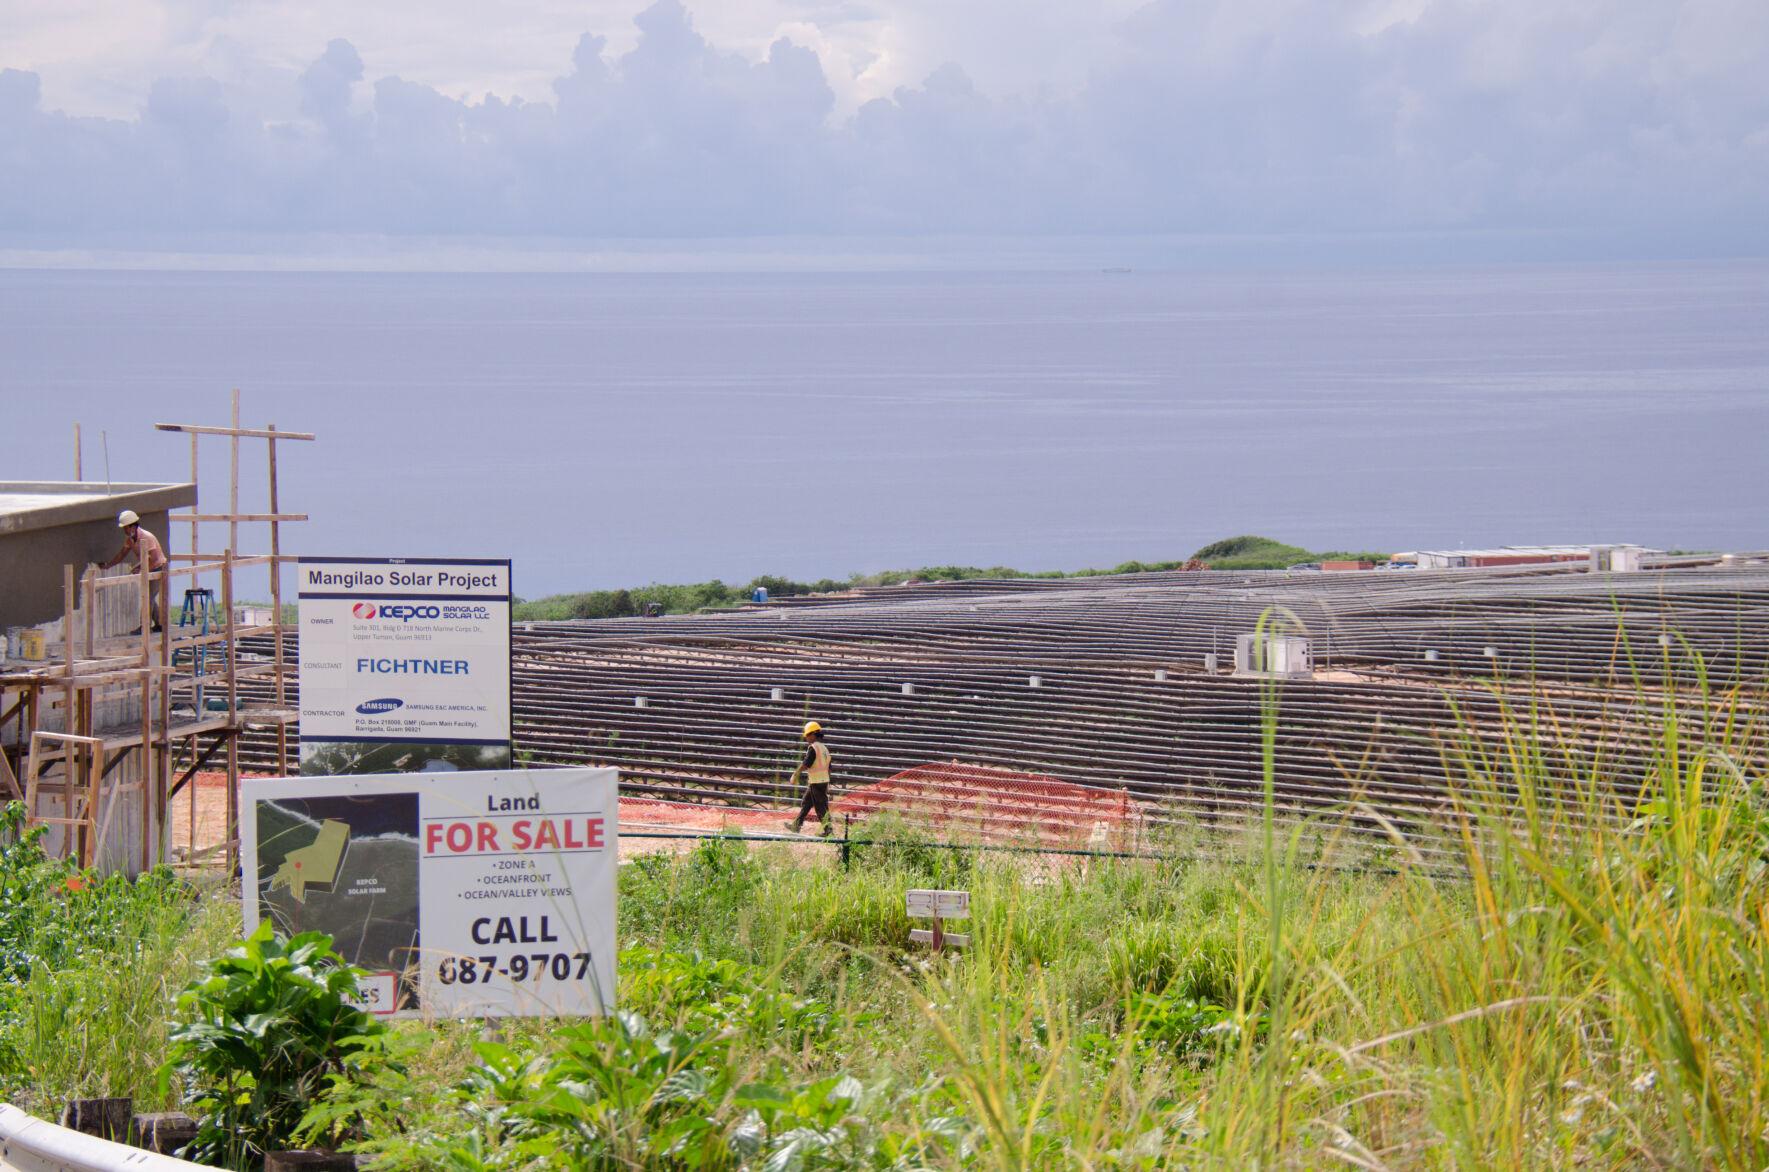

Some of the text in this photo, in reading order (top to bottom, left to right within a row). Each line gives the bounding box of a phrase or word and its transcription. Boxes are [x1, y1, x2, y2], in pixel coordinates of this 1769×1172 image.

[308, 570, 497, 589] Mangilao Solar Project
[379, 605, 440, 622] KEPCO
[356, 658, 470, 675] FICHTNER
[361, 702, 398, 710] SAMSUNG
[487, 792, 540, 811] Land
[426, 818, 605, 854] FOR SALE
[498, 860, 536, 869] ZONE A
[483, 873, 552, 885] OCEANFRONT
[464, 888, 538, 900] OCEAN/VALLEY
[471, 915, 558, 945] CALL
[438, 953, 592, 985] 687-9707
